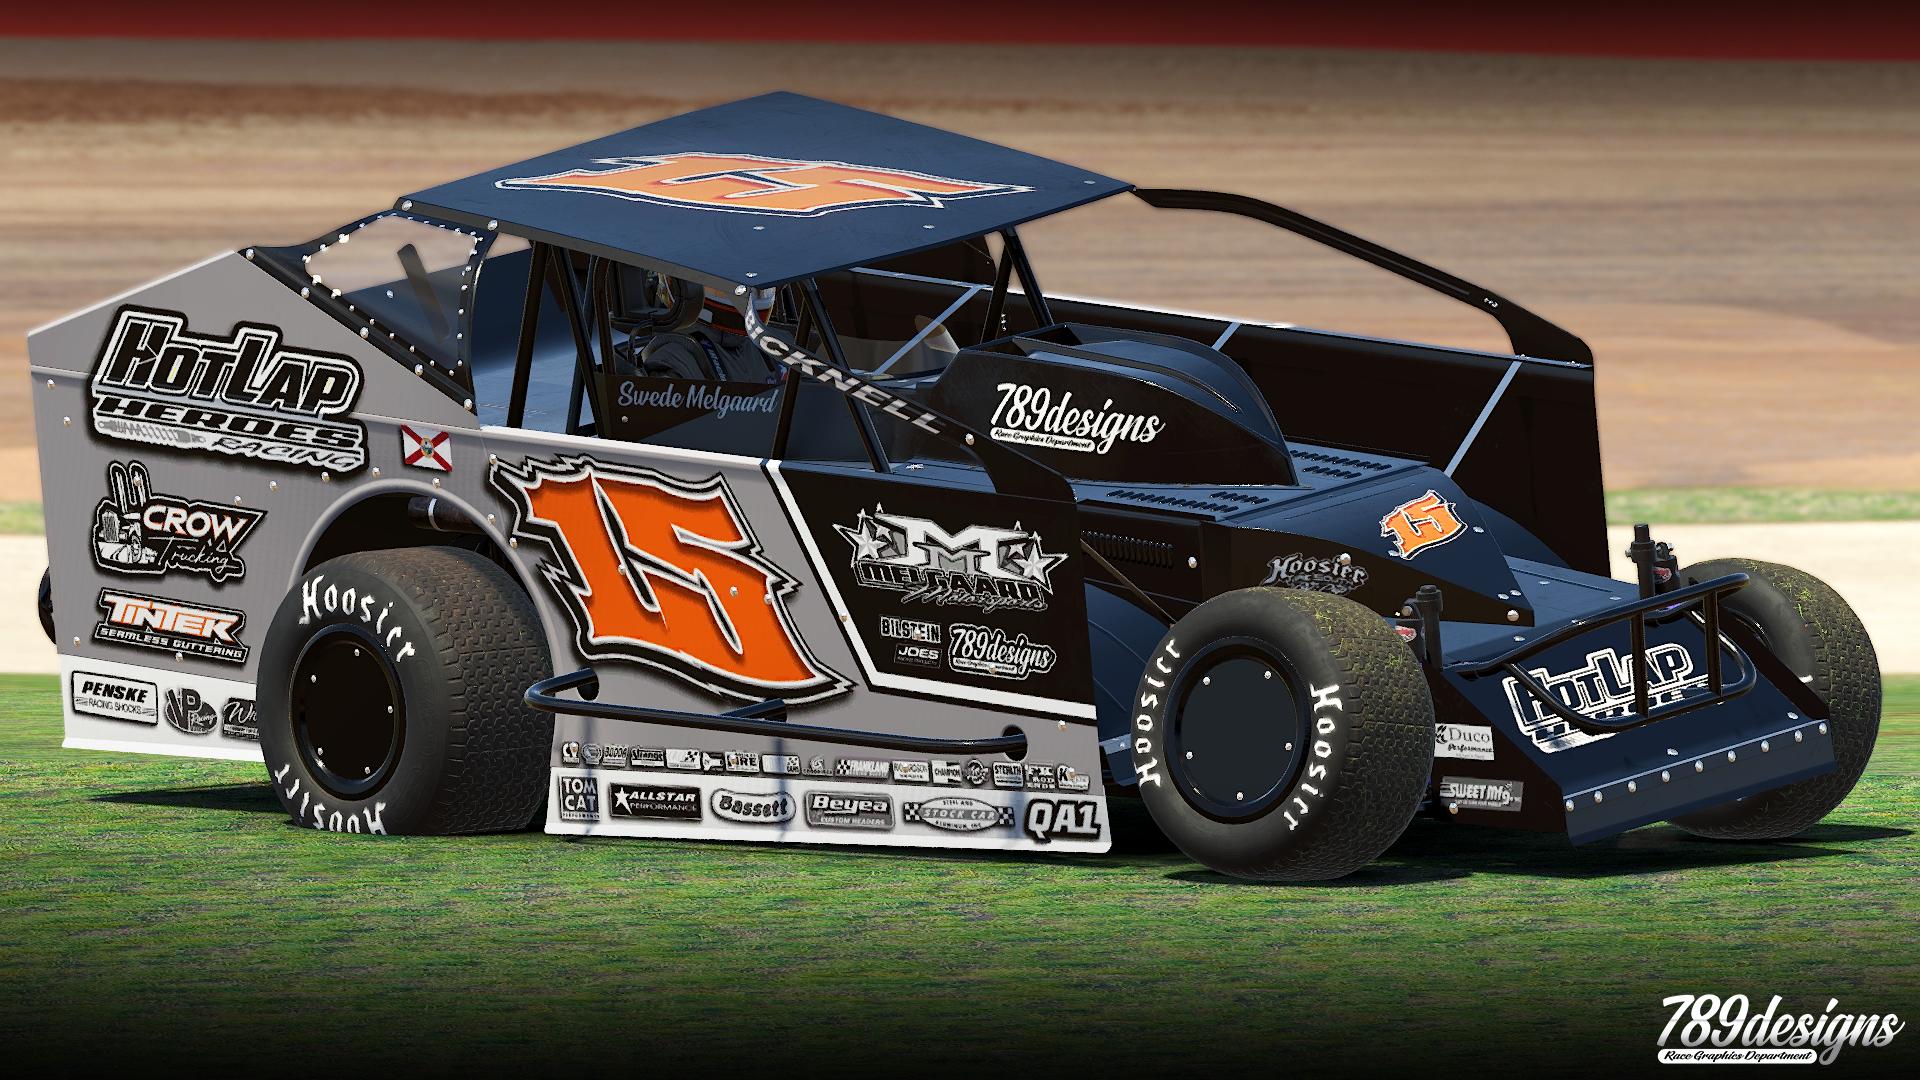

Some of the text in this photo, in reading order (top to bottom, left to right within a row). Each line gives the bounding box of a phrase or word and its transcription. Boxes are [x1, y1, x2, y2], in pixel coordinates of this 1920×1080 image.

[617, 380, 780, 419] Swede Melgaard
[97, 397, 360, 448] HEROES
[990, 382, 1167, 455] 789designs
[142, 504, 248, 543] CROW
[1382, 492, 1465, 558] 15
[148, 535, 239, 574] Trucking
[503, 458, 842, 696] 15
[880, 616, 941, 644] BILSTEIN
[99, 628, 244, 660] SEAMLESS GUTTERING
[898, 646, 940, 660] JOES
[951, 628, 1052, 675] 789designs
[81, 680, 149, 705] PENSKE
[88, 698, 142, 716] RACING SHOCKS
[166, 688, 202, 731] VP
[1447, 727, 1490, 744] Duco
[562, 778, 596, 795] TOM
[629, 791, 696, 802] ALLSTAR
[1449, 782, 1487, 799] SWEET
[564, 794, 596, 811] CAT
[629, 802, 698, 812] PERFORMANCE
[718, 795, 789, 818] Bassett
[812, 794, 889, 815] Beyea
[923, 808, 996, 820] STOCK CAR
[1027, 801, 1100, 841] QA1
